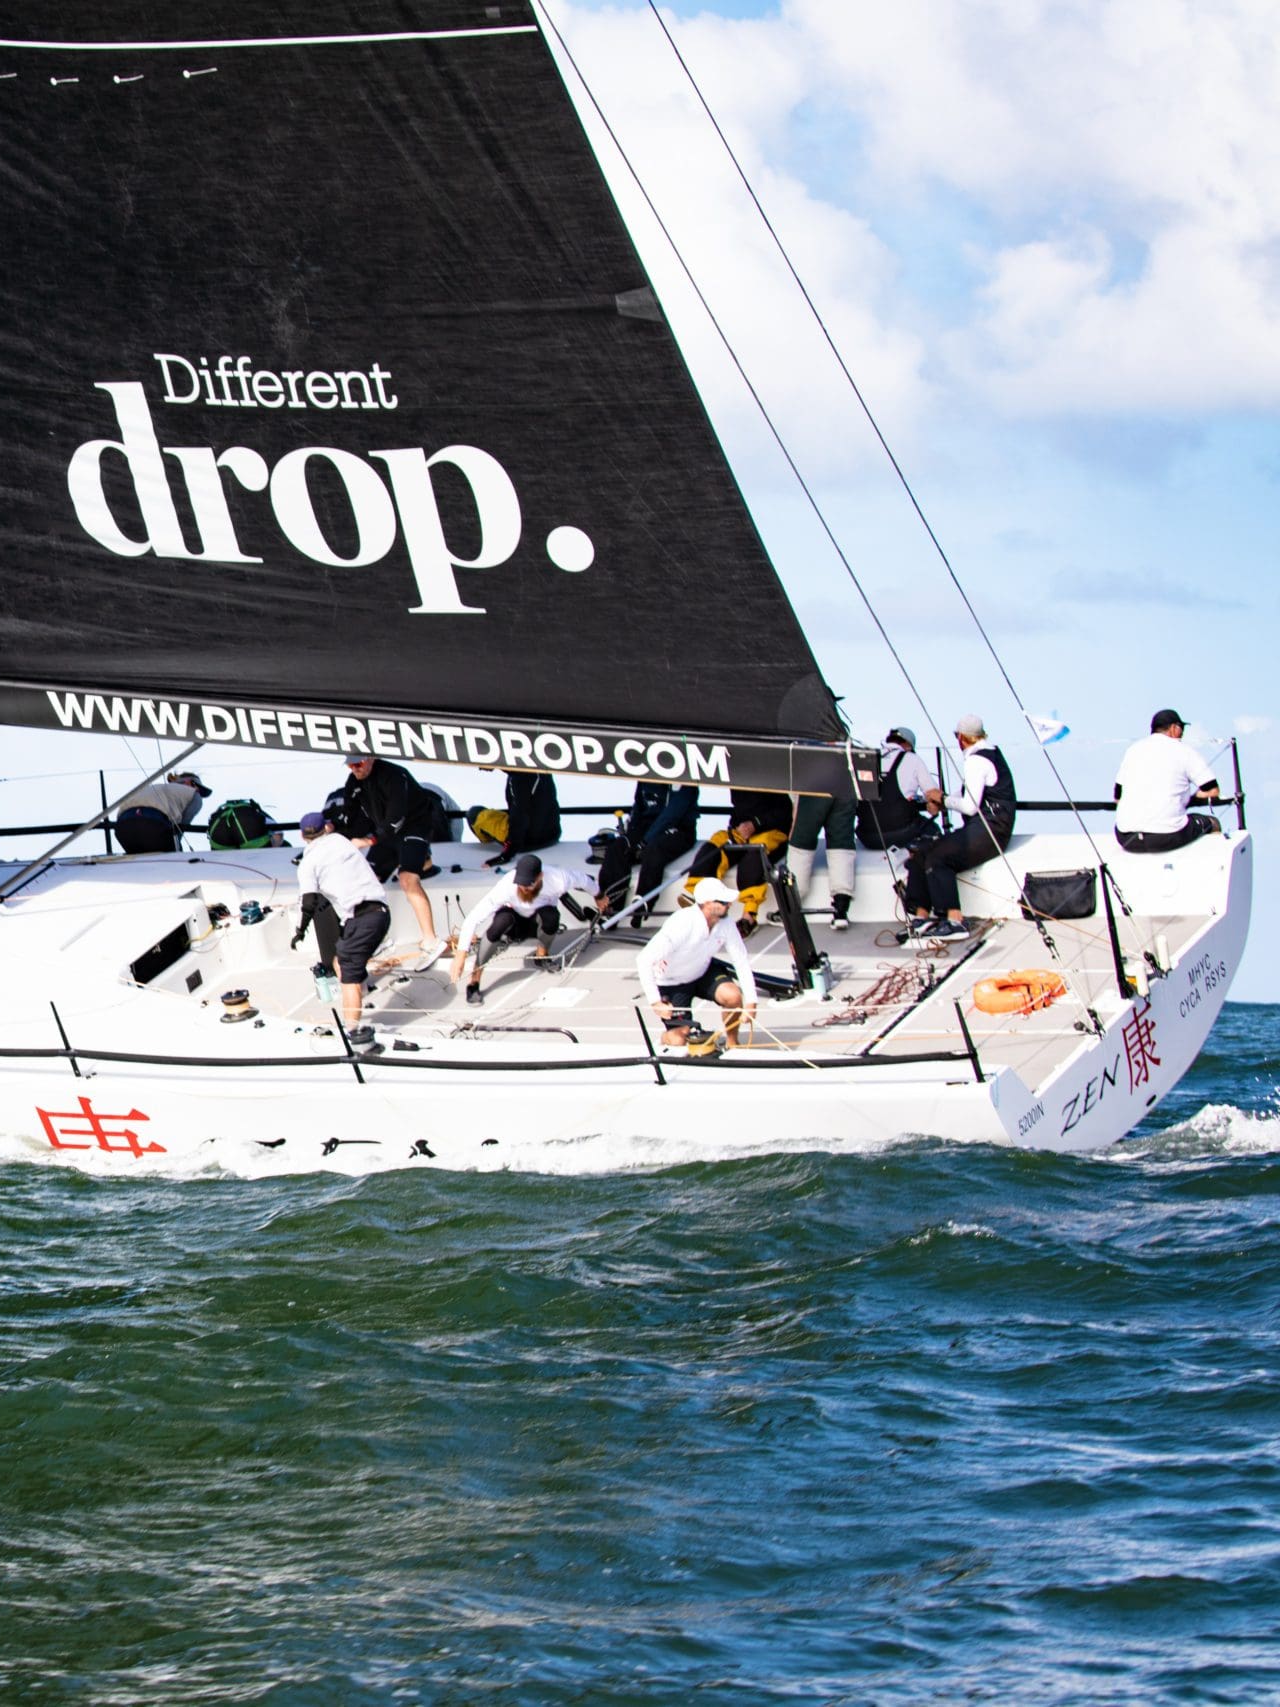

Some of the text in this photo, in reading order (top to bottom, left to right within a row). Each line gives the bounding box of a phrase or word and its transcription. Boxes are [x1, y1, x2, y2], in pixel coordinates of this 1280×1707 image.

[153, 353, 399, 410] Different
[67, 381, 595, 614] drop.
[46, 690, 731, 783] WWW.DIFFERENTDROP.COM
[1179, 961, 1227, 1018] CYCA RSYS
[1187, 953, 1212, 985] MHYC
[1121, 1002, 1161, 1096] 康
[1061, 1053, 1121, 1137] ZEN
